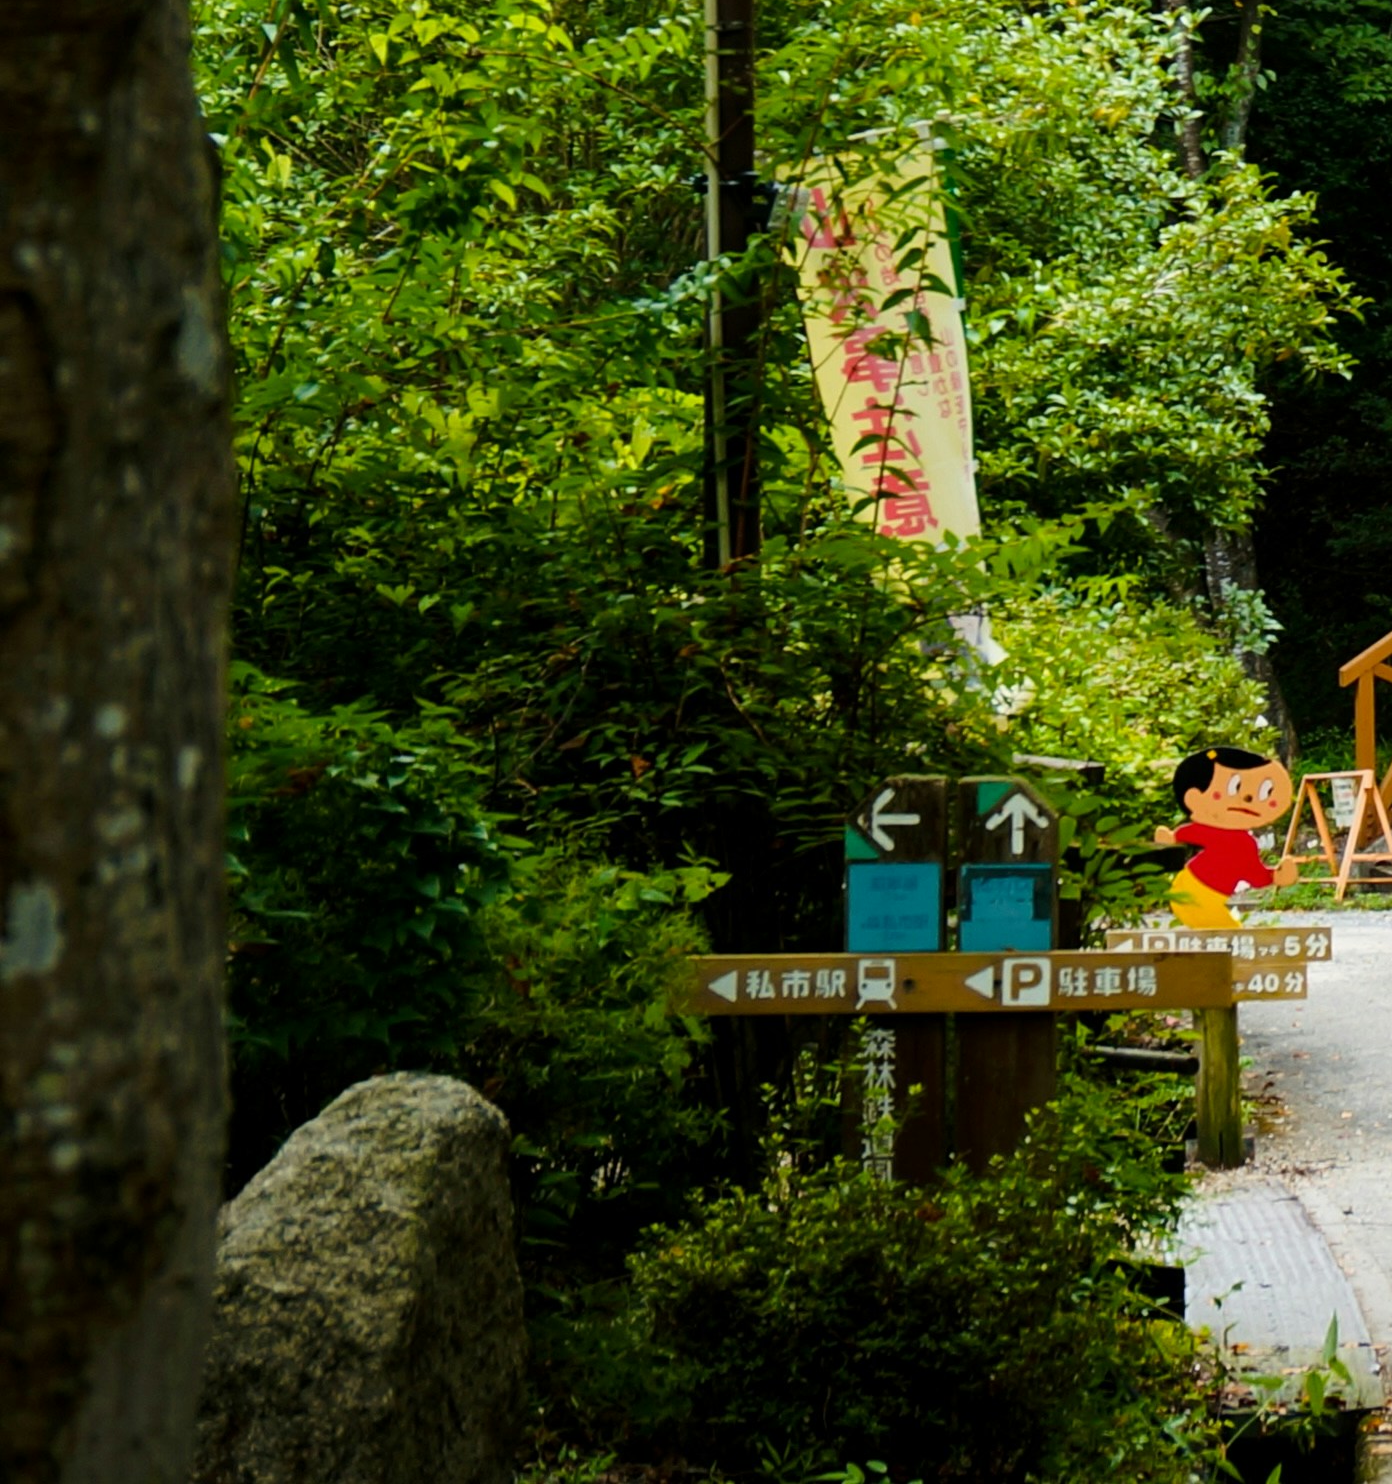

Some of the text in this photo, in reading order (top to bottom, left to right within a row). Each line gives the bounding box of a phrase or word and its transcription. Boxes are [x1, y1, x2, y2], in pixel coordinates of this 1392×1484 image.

[745, 968, 848, 1000] 私市駅
[1057, 965, 1158, 998] 駐車場
